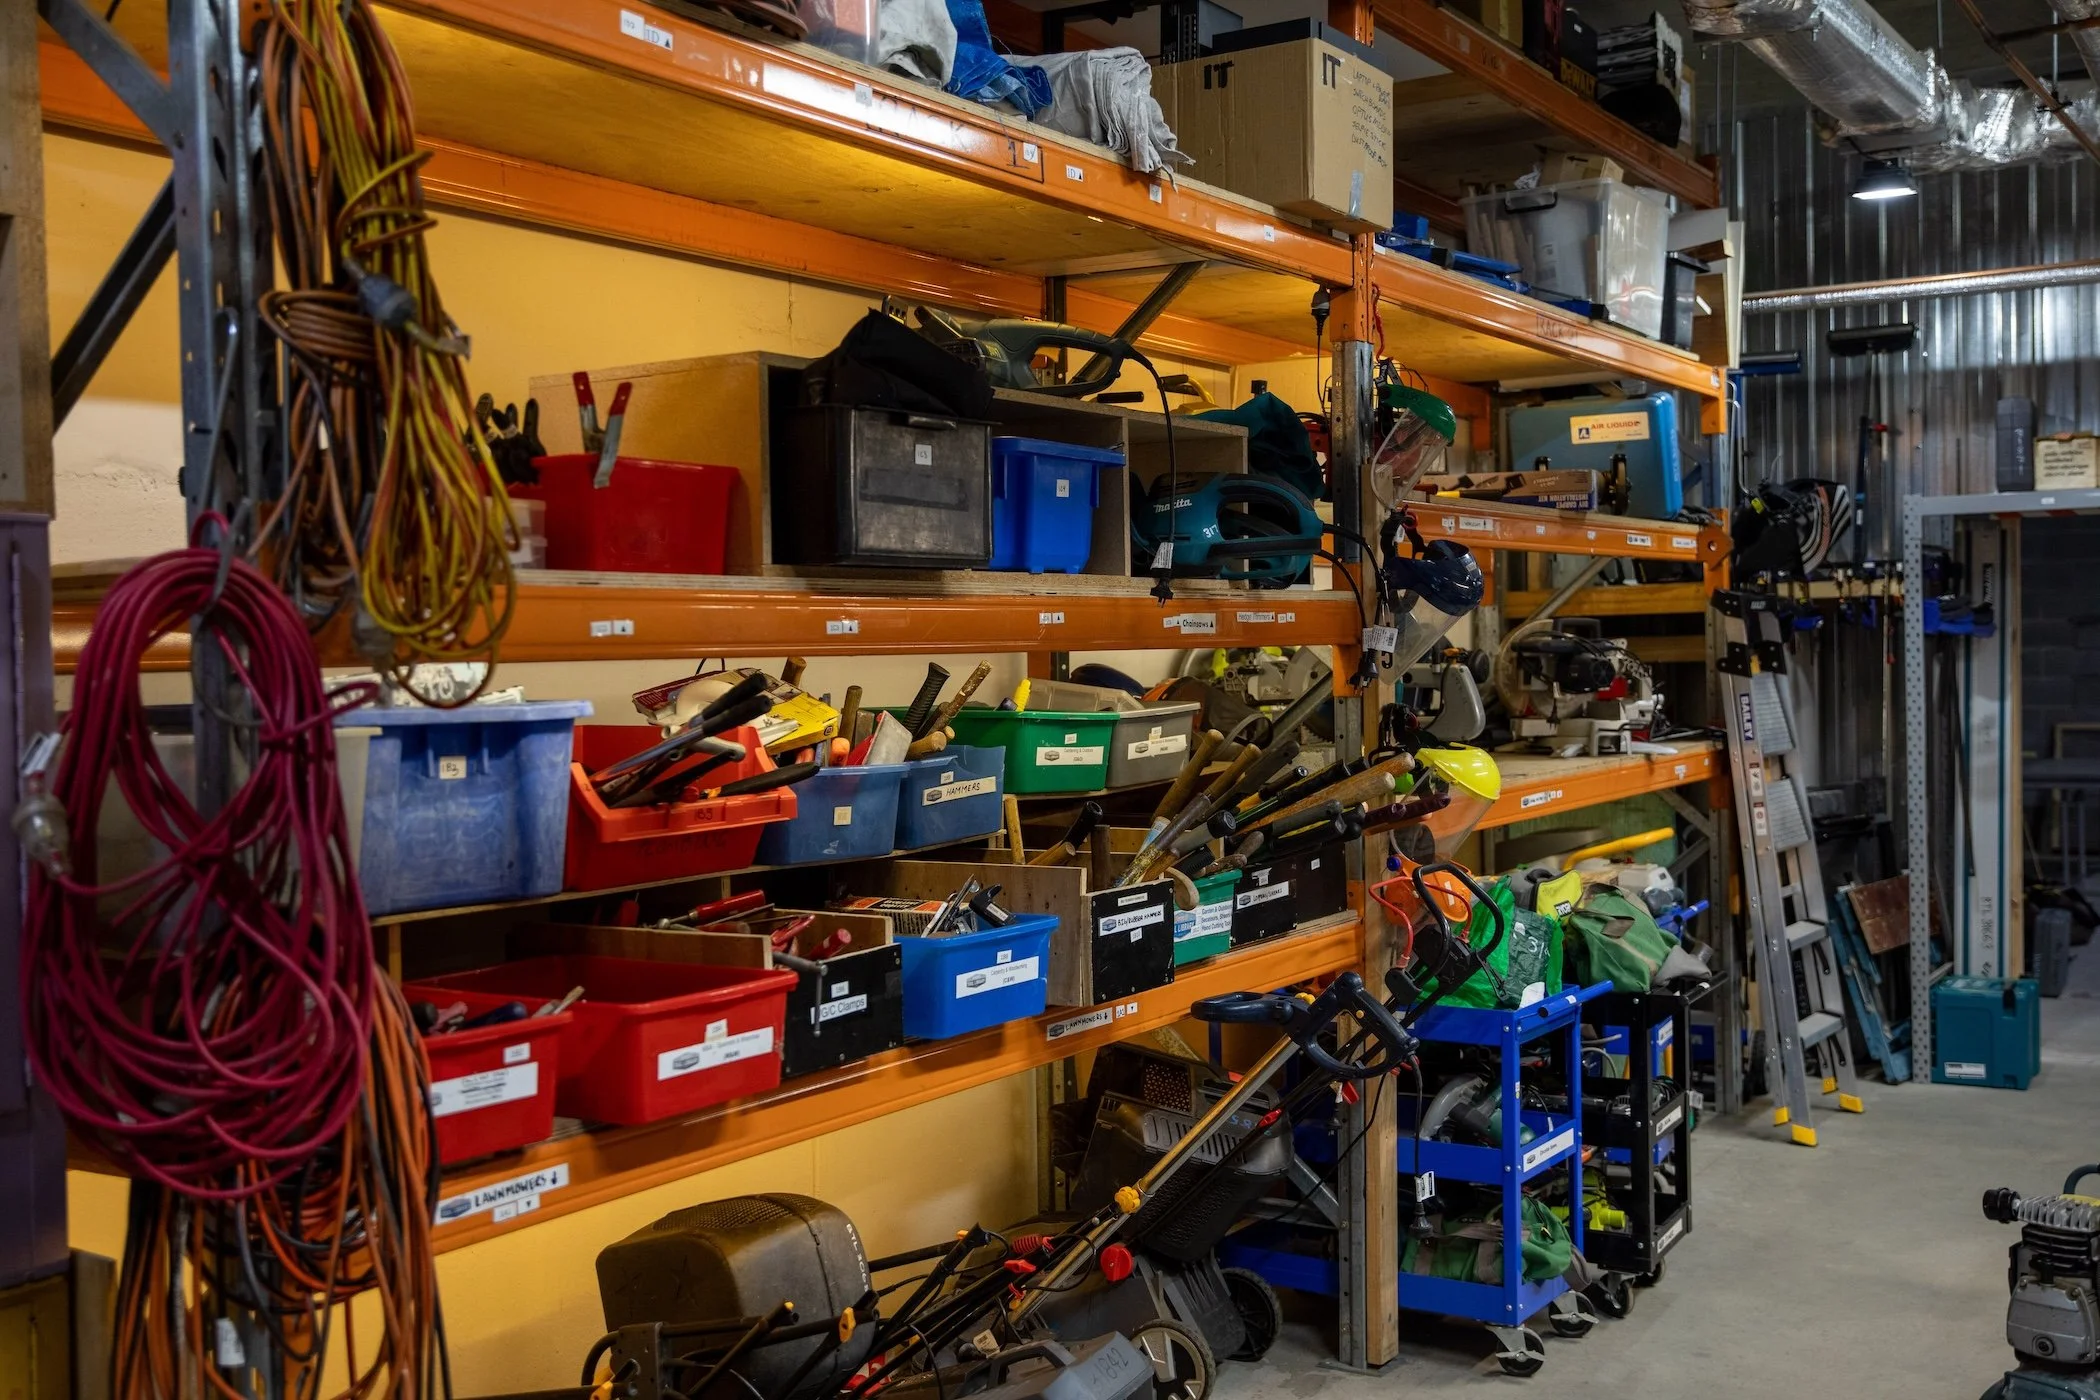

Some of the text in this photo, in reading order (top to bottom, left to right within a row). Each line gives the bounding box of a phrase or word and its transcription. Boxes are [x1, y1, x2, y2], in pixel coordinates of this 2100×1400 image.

[1204, 60, 1234, 89] IT
[1322, 53, 1341, 89] IT
[1182, 618, 1210, 628] Chainsaws
[1741, 696, 1754, 740] BAILEY
[946, 782, 981, 797] HAMMERS
[1065, 1012, 1102, 1032] LAWNMOWERS
[475, 1173, 547, 1208] LAWNMOWERS
